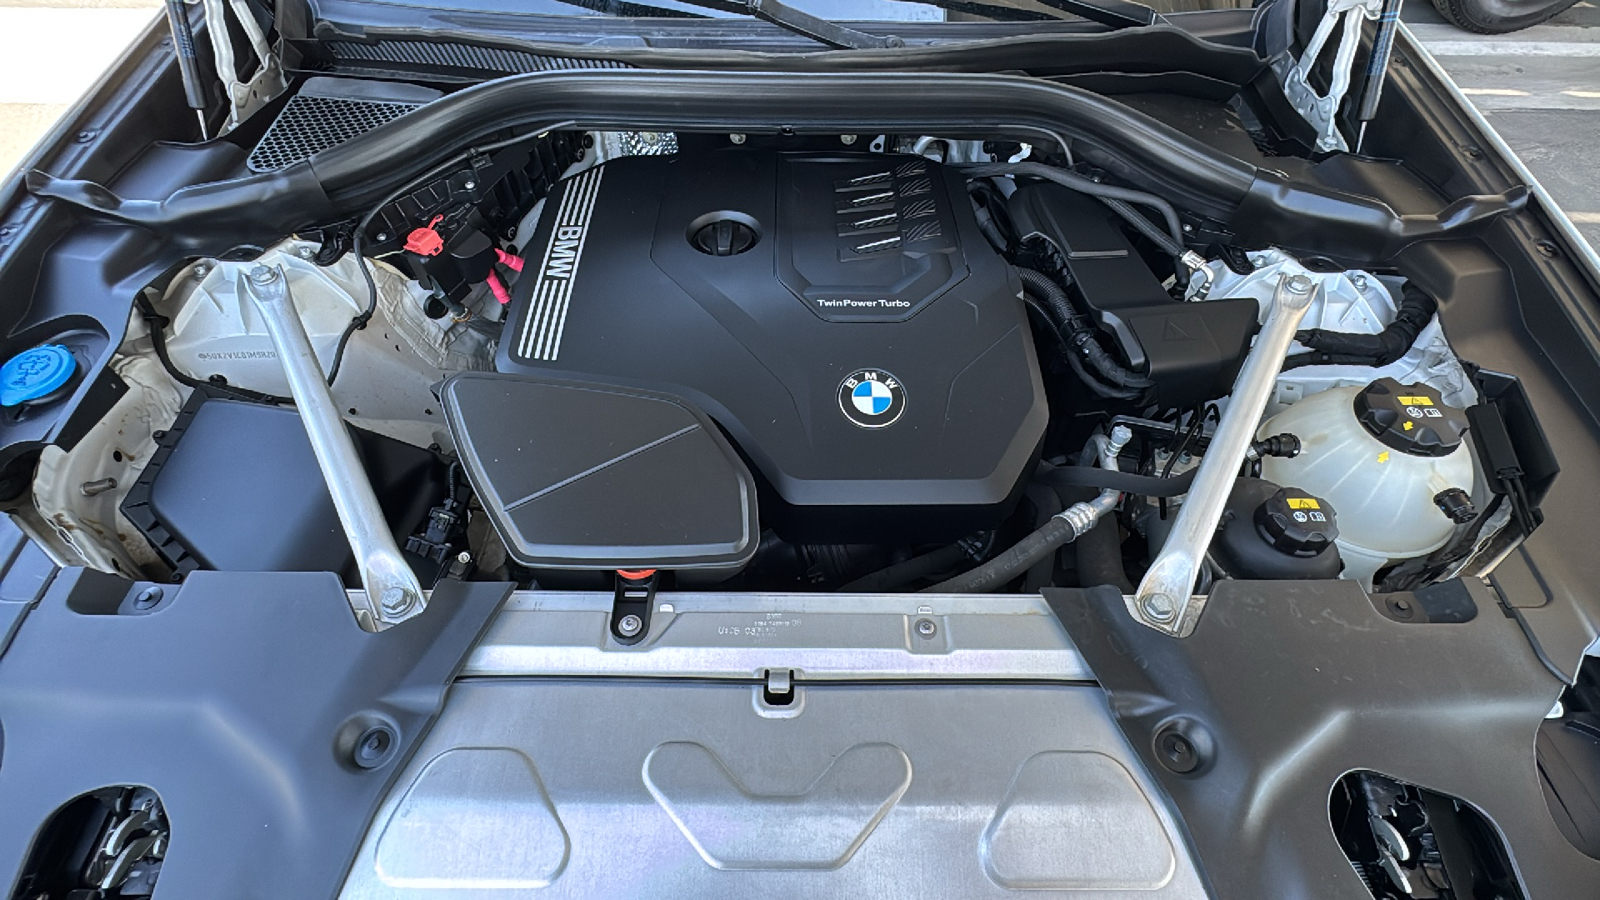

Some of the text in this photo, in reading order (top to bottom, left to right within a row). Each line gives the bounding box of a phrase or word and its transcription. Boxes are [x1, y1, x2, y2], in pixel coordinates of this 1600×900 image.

[546, 226, 583, 279] BMW
[816, 299, 911, 308] TwinPower Turbo
[845, 371, 898, 389] BMW
